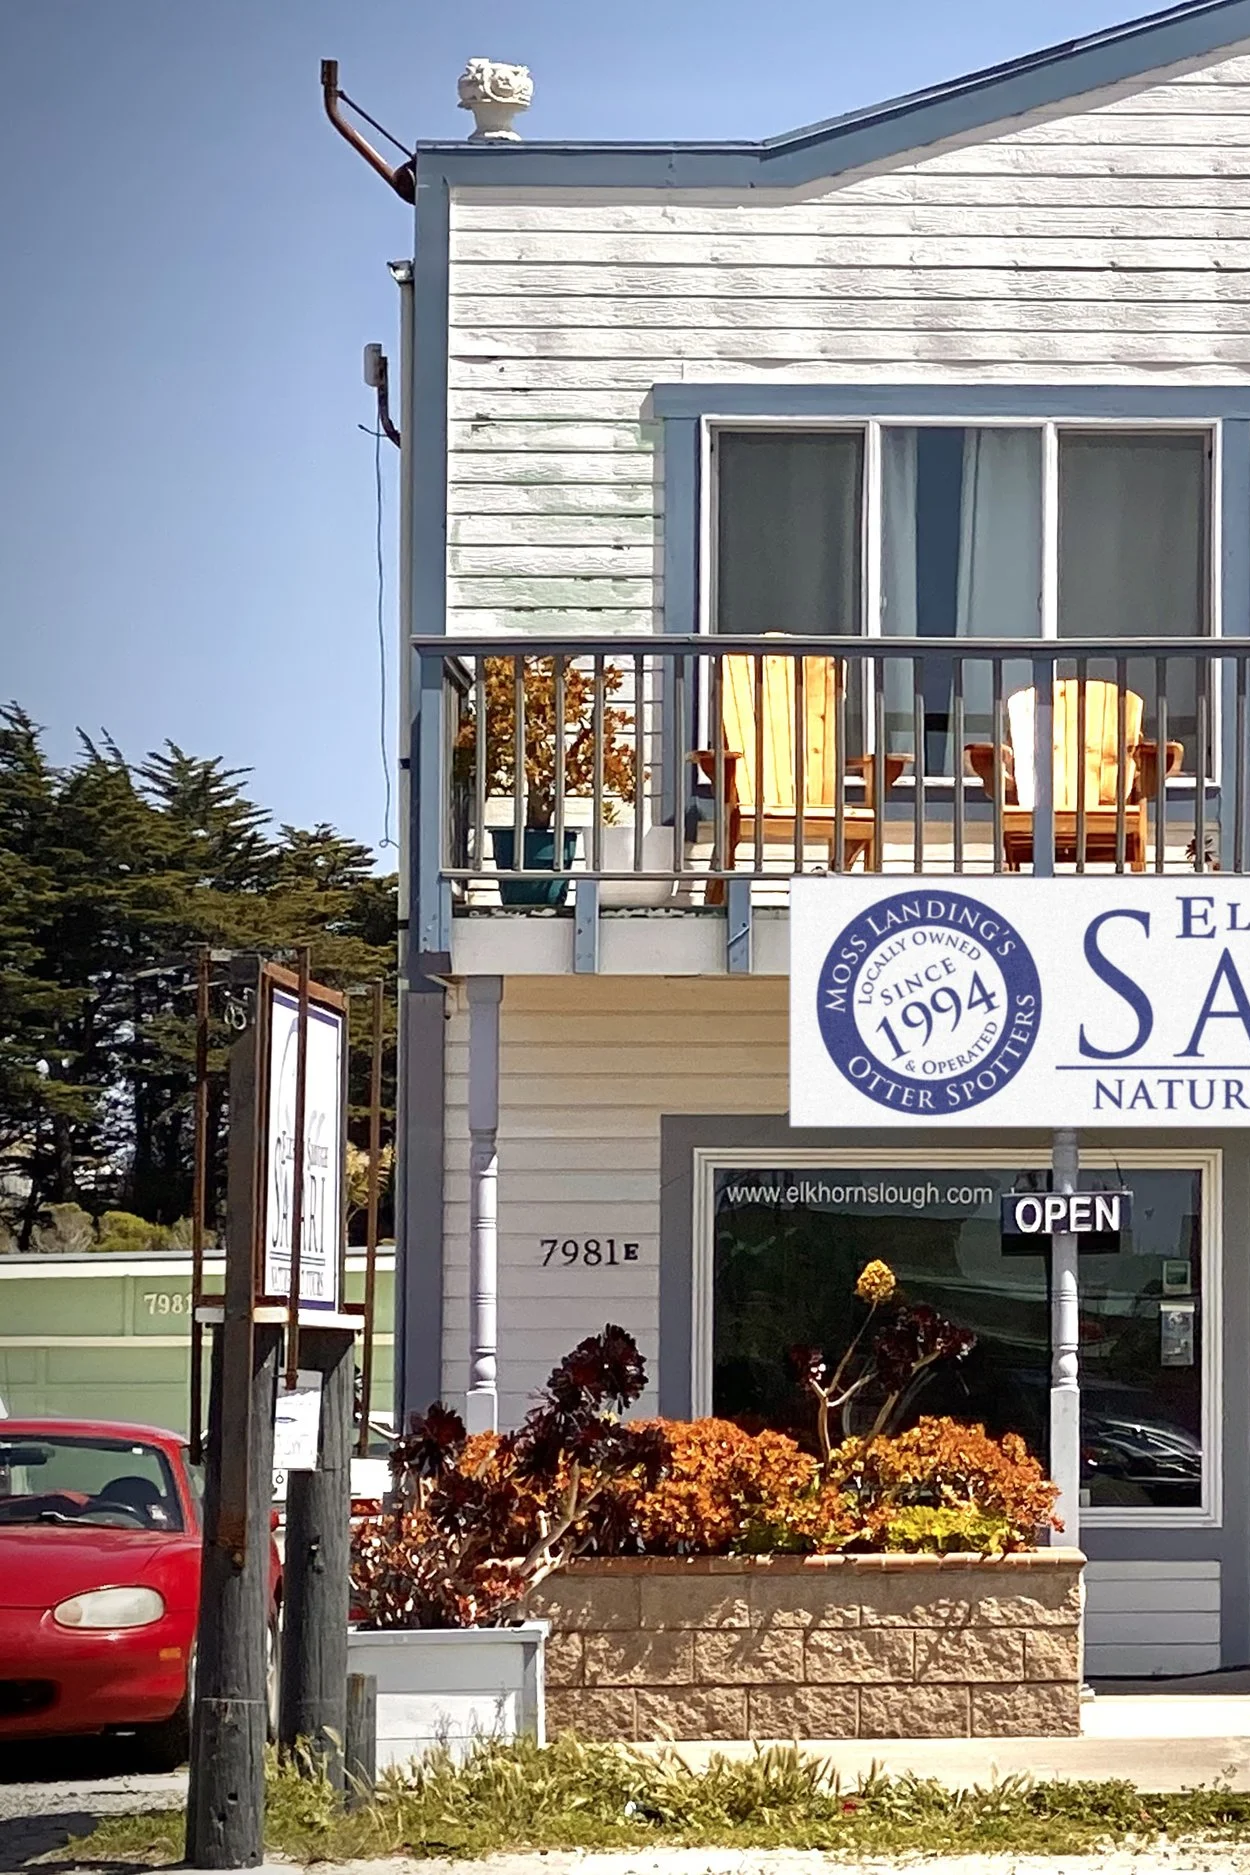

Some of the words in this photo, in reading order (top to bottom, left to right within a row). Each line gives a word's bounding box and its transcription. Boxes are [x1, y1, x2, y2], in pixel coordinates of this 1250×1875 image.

[825, 934, 867, 1013] MOSS
[866, 900, 1016, 957] LANDING'S
[858, 937, 907, 1005] LOCALLY
[912, 931, 982, 962] OWNED
[880, 957, 957, 1006] SINCE
[876, 970, 1000, 1062] 1994
[904, 1058, 917, 1073] &
[922, 1020, 998, 1075] OPERATED
[848, 1055, 936, 1109] OTTER
[946, 993, 1036, 1106] SPOTTERS
[726, 1182, 993, 1209] www.elkhornslough.com
[1014, 1196, 1121, 1234] OPEN
